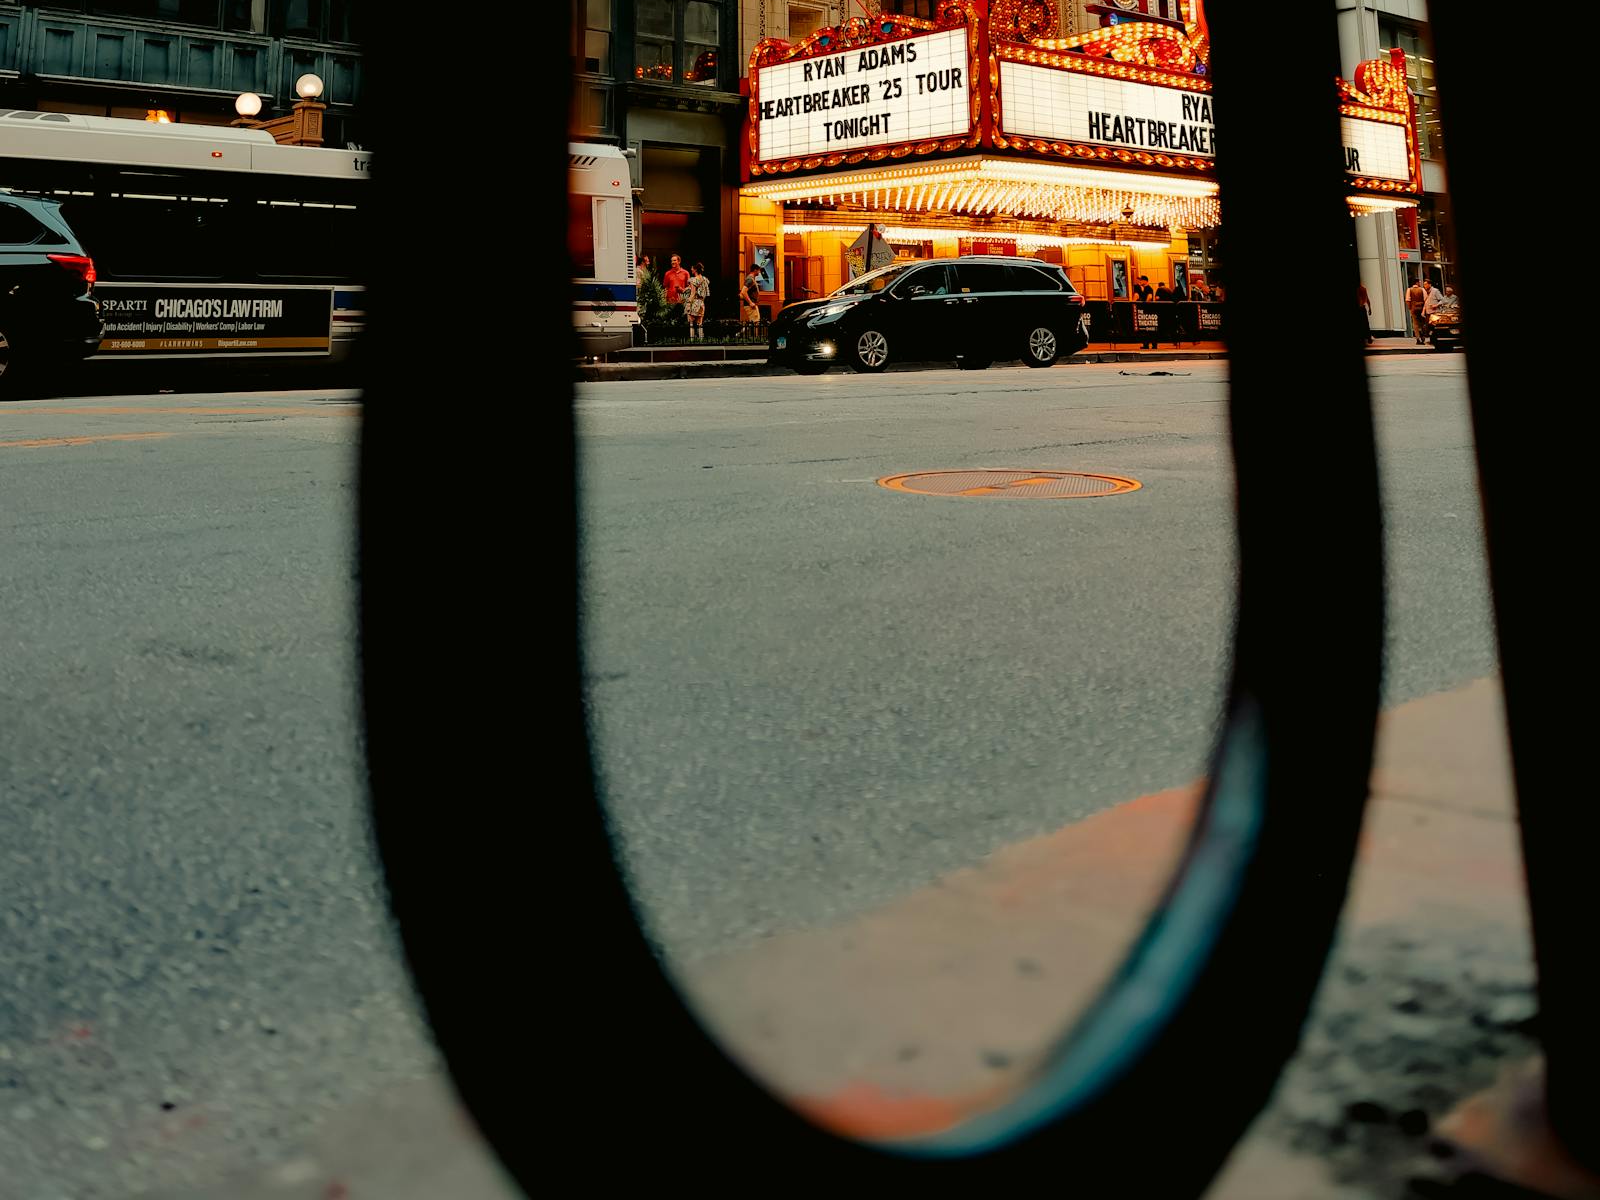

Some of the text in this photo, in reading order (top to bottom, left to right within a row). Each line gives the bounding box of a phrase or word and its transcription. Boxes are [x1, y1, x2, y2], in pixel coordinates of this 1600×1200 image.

[804, 42, 917, 82] RYAN ADAMS
[759, 68, 962, 121] HEARTBREAKER '25 TOUR
[824, 113, 891, 142] TONIGHT
[155, 299, 283, 318] CHICAGO'S LAW FIRM
[117, 322, 142, 331] Accident
[146, 323, 163, 332] Injury
[166, 322, 193, 332] Disability
[219, 322, 235, 332] Comp
[238, 322, 253, 331] Labor
[253, 323, 265, 331] Law
